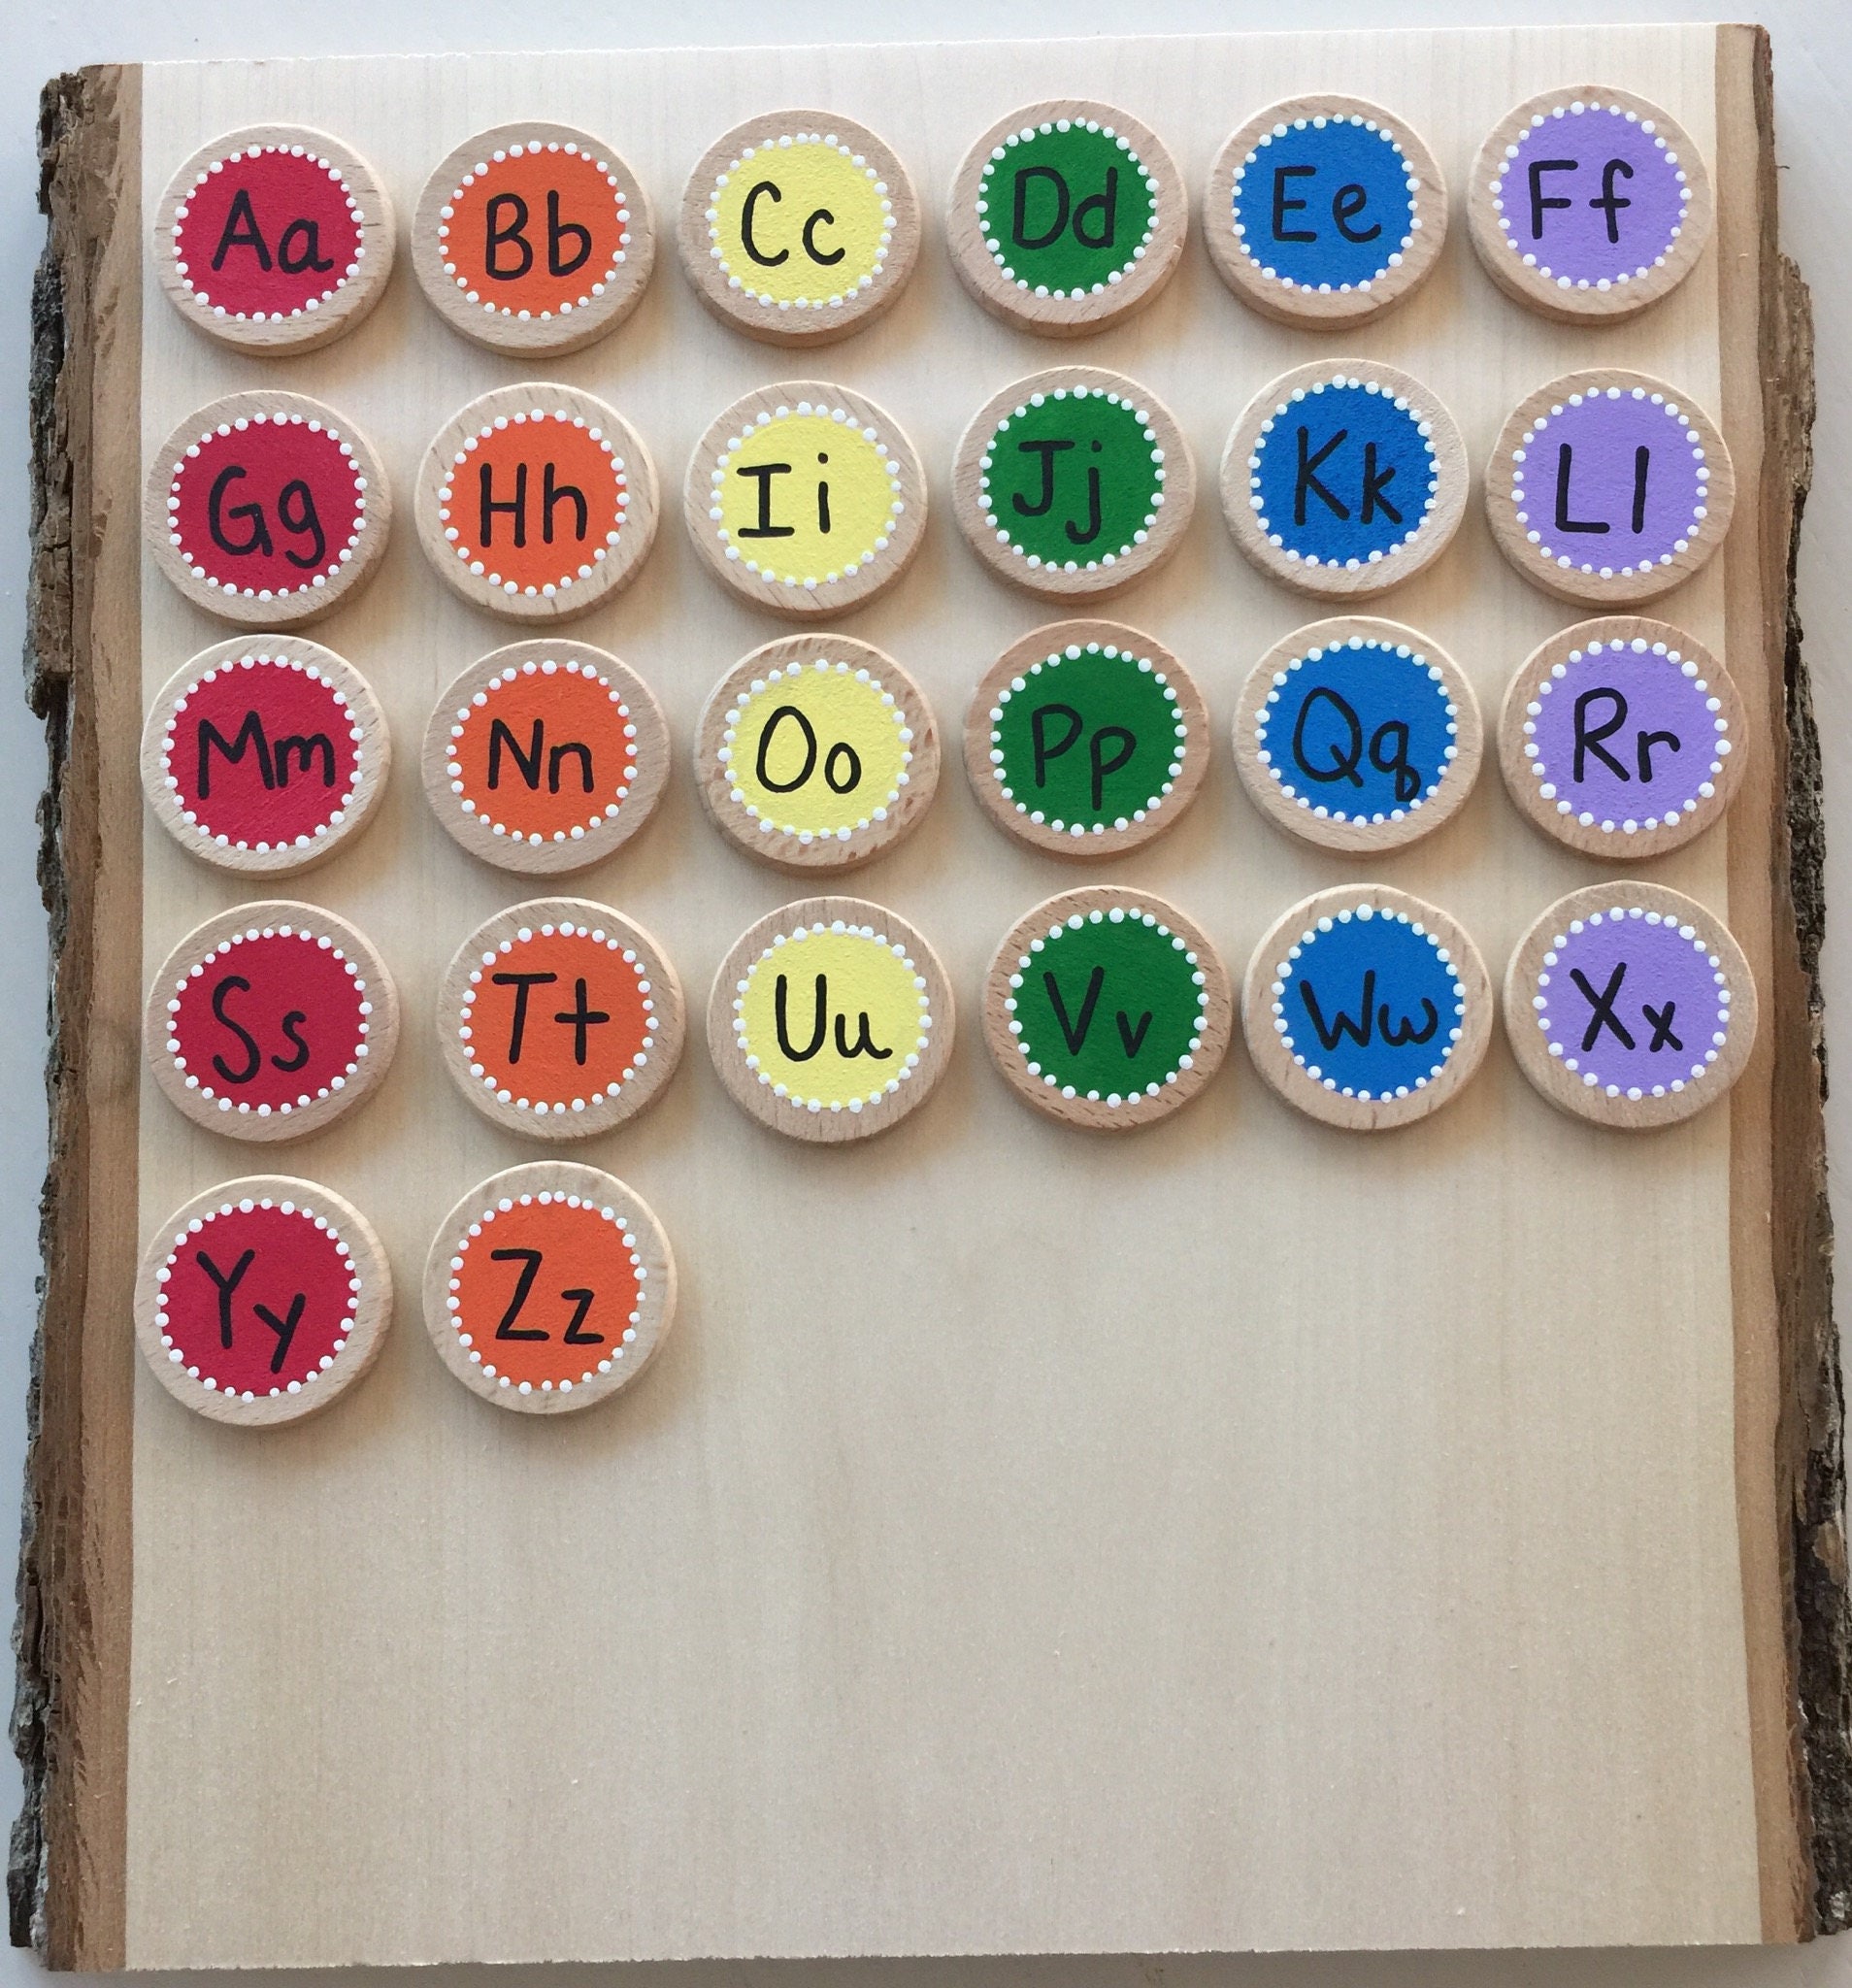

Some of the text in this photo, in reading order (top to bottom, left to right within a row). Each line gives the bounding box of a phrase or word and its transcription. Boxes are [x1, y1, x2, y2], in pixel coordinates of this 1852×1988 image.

[212, 189, 335, 275] Aa
[485, 189, 592, 281] Bb
[741, 181, 845, 267] Cc
[1011, 165, 1119, 250] Dd
[1273, 166, 1381, 244] Ee
[1529, 159, 1634, 244] Ff
[208, 465, 326, 569] Gg
[480, 462, 587, 547] Hh
[736, 452, 831, 538] Ii
[1011, 437, 1104, 546] Jj
[1294, 426, 1403, 526] Kk
[197, 711, 336, 800] Mm
[487, 718, 594, 794] Nn
[755, 706, 862, 794] Oo
[1030, 702, 1139, 812] Pp
[1292, 687, 1421, 803] Qq
[1573, 687, 1681, 783] Rr
[212, 976, 310, 1084] Ss
[491, 973, 611, 1066] Tt
[775, 974, 893, 1062] Uu
[1042, 965, 1154, 1060] Vv
[1300, 971, 1439, 1051] Ww
[1570, 962, 1683, 1053] Xx
[196, 1248, 306, 1375] Yy
[490, 1248, 605, 1345] Zz
